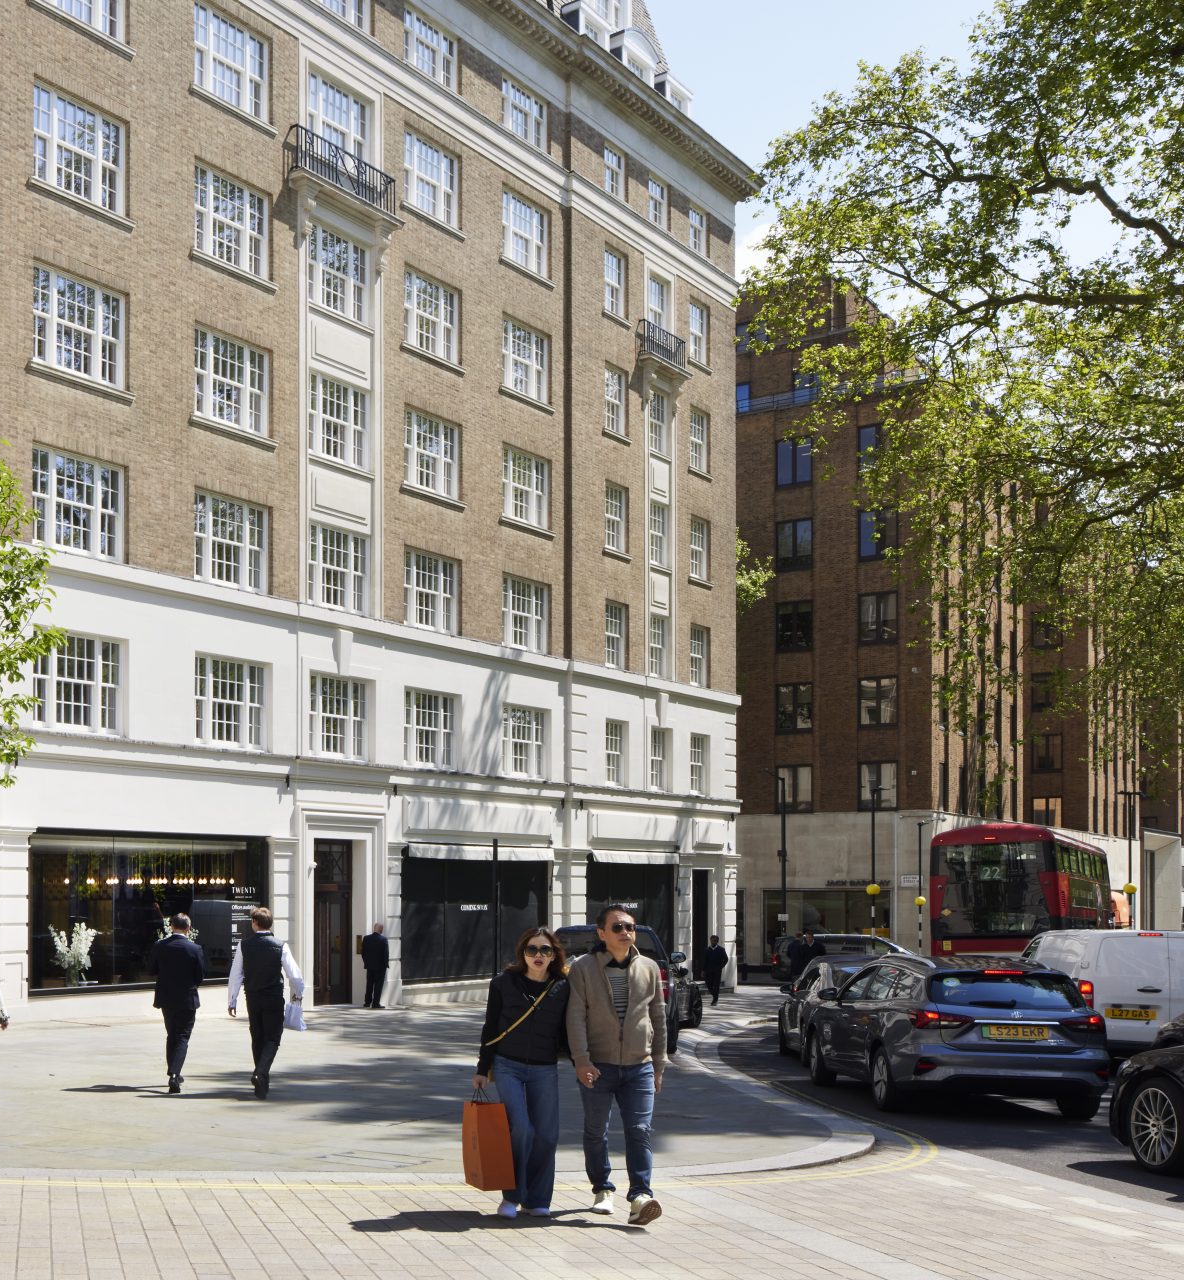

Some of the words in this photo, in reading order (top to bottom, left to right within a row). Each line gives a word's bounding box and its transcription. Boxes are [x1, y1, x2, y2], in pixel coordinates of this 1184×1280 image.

[982, 867, 1000, 879] 22
[232, 886, 256, 894] TWENTY
[1111, 1009, 1129, 1017] L27
[989, 1026, 1018, 1036] LS23
[1022, 1027, 1044, 1037] EKR
